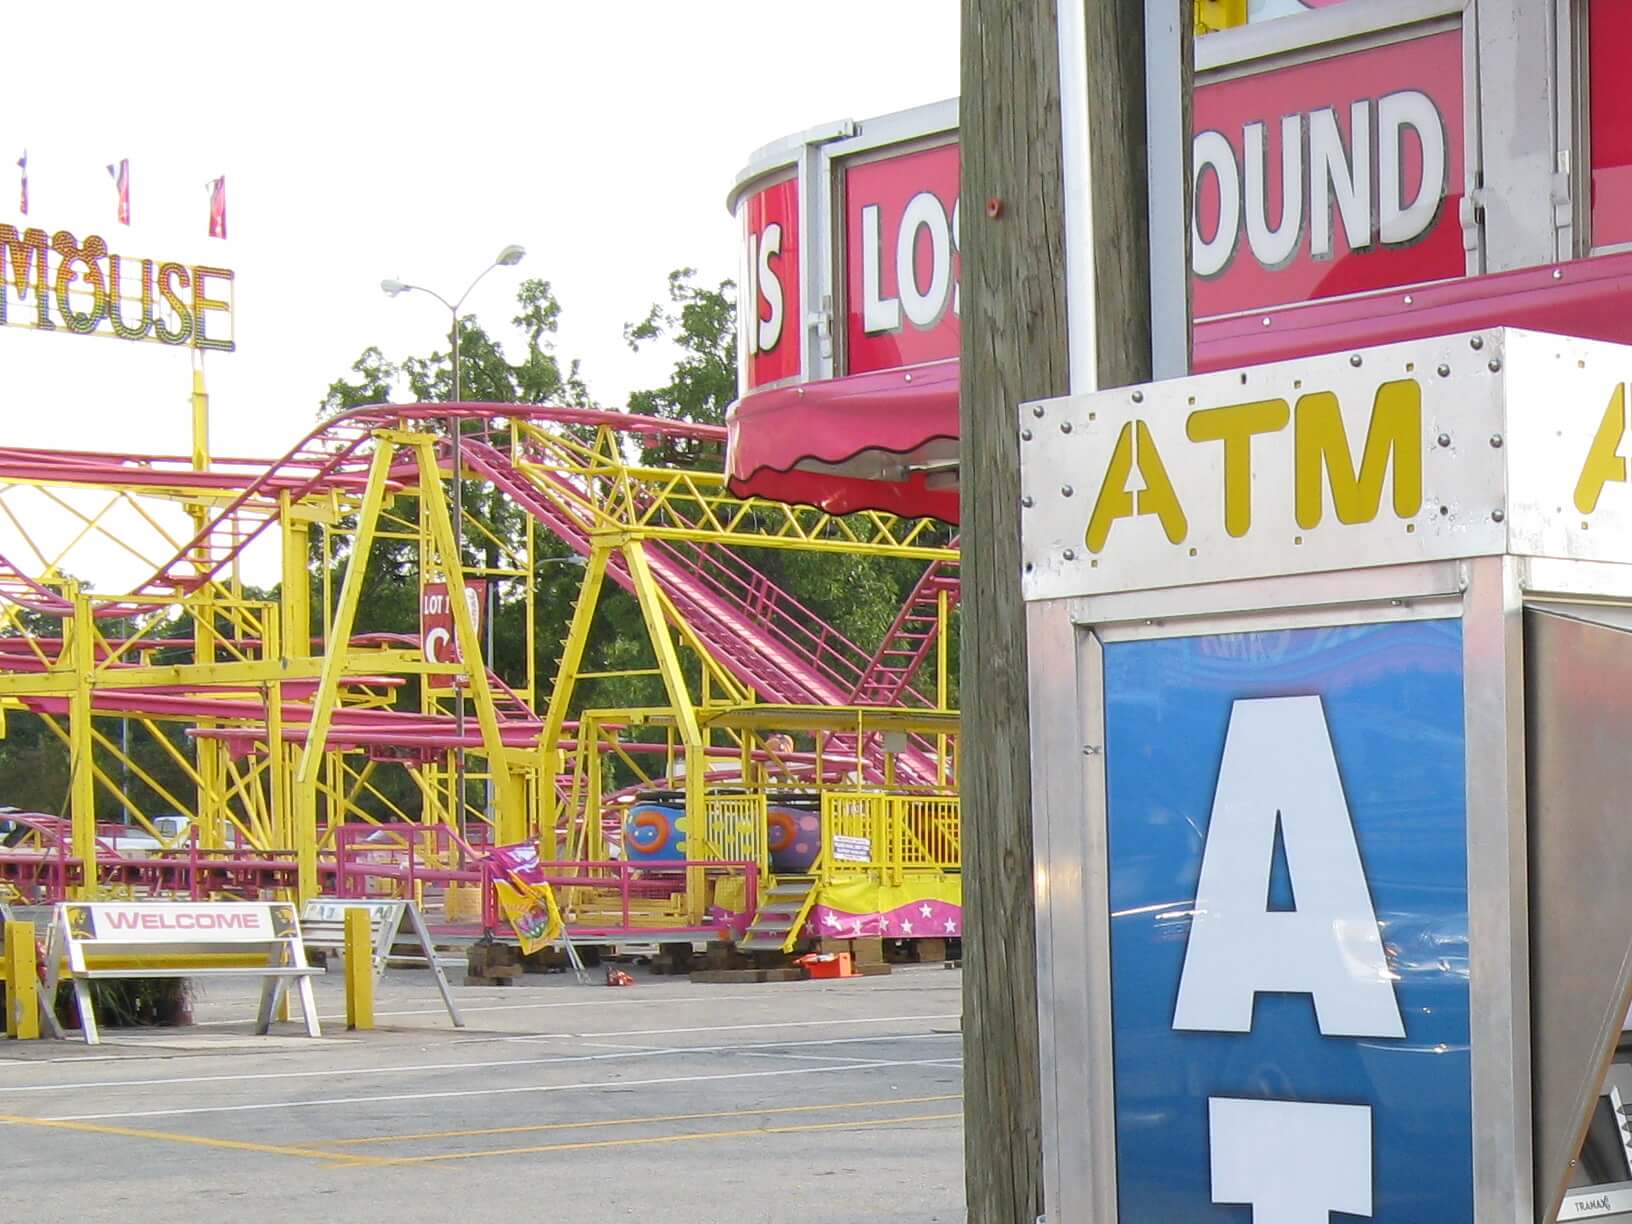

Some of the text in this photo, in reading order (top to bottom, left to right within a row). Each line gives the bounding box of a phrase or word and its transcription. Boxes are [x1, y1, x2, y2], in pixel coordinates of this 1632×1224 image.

[0, 223, 235, 352] MOUSE
[1086, 378, 1422, 554] ATM
[105, 911, 261, 930] WELCOME
